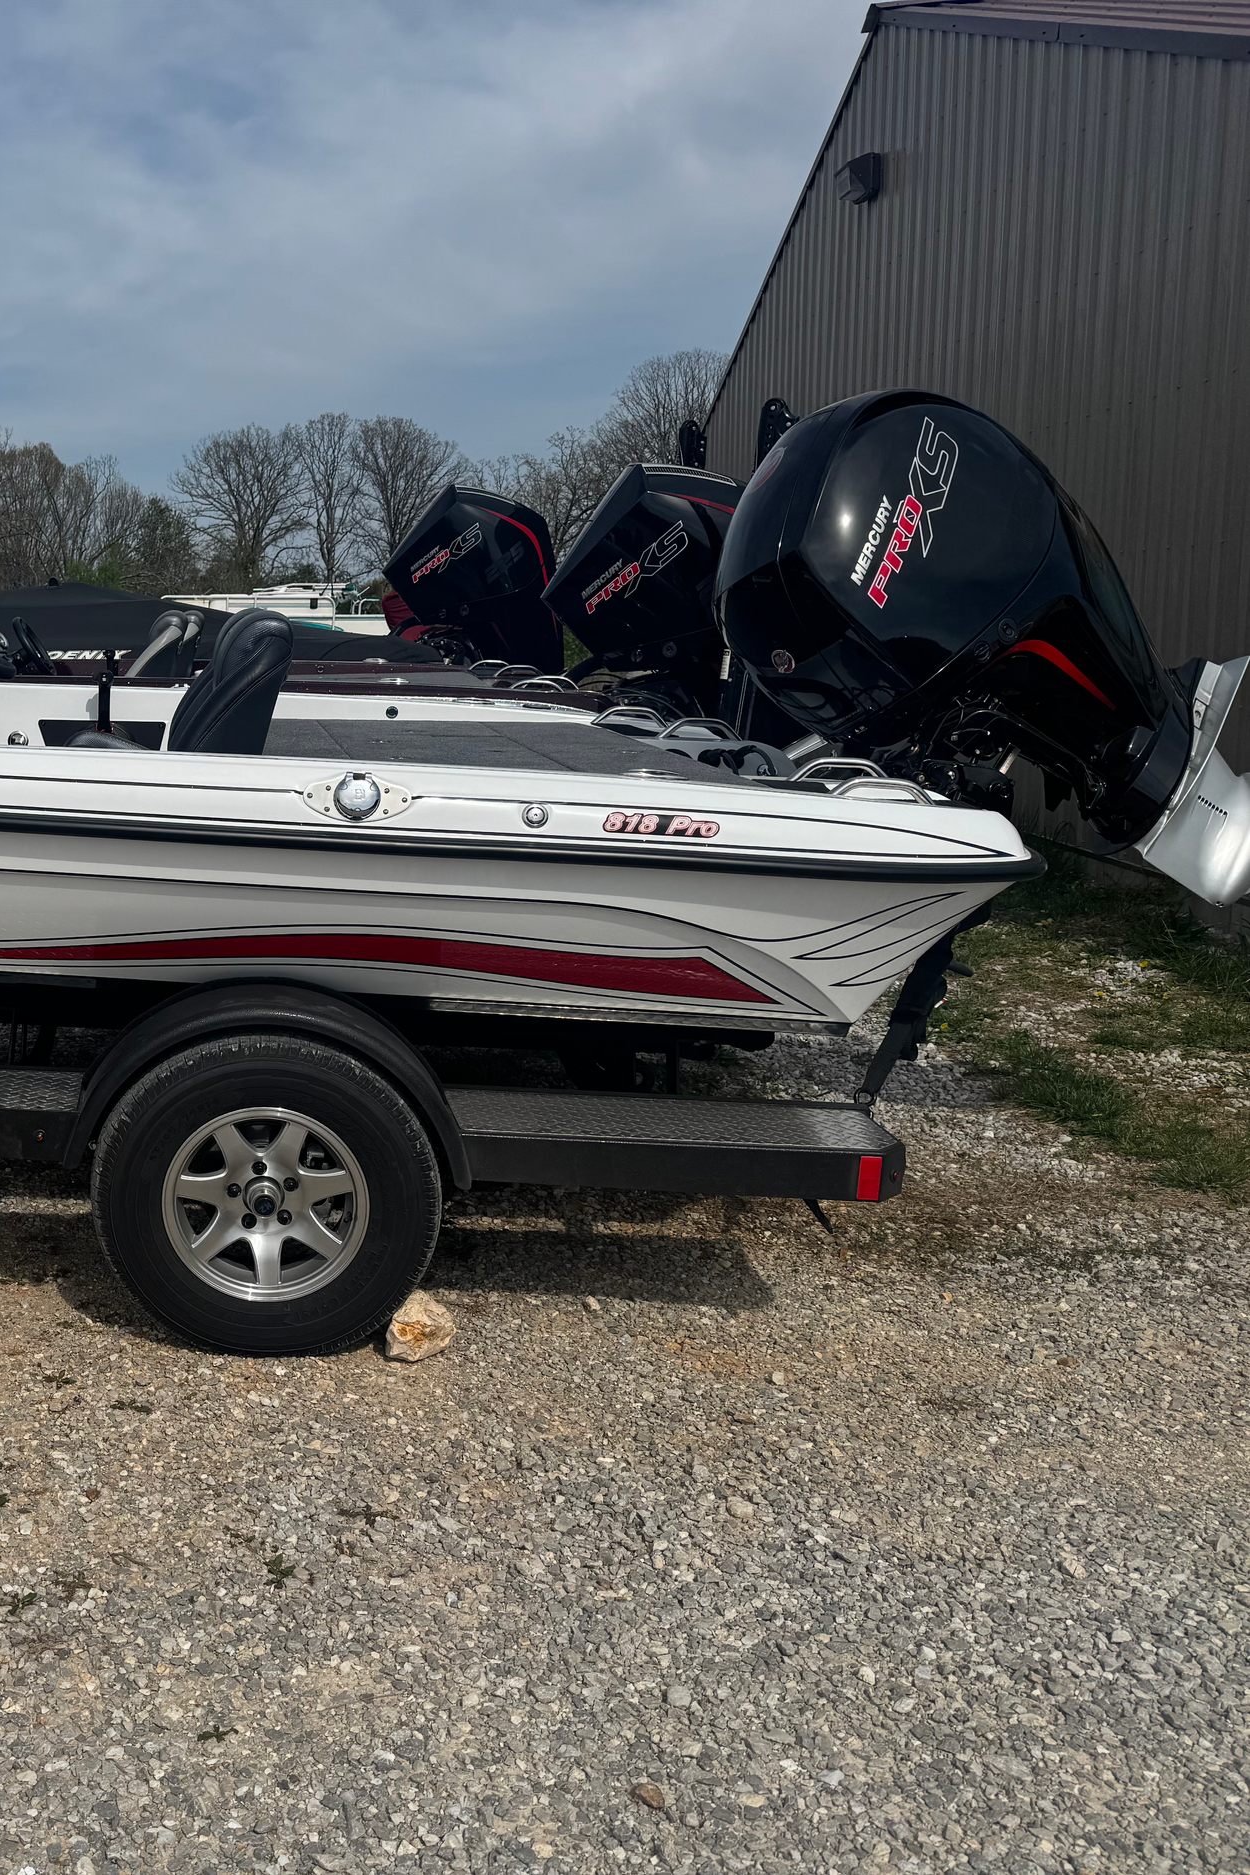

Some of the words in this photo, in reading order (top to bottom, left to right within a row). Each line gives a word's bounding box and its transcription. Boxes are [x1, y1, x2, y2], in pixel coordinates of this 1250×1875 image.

[850, 495, 893, 586] MERCURY
[410, 545, 440, 572] MERCURY
[581, 558, 623, 600] MERCURY
[602, 812, 659, 834] 818
[665, 815, 720, 838] Pro
